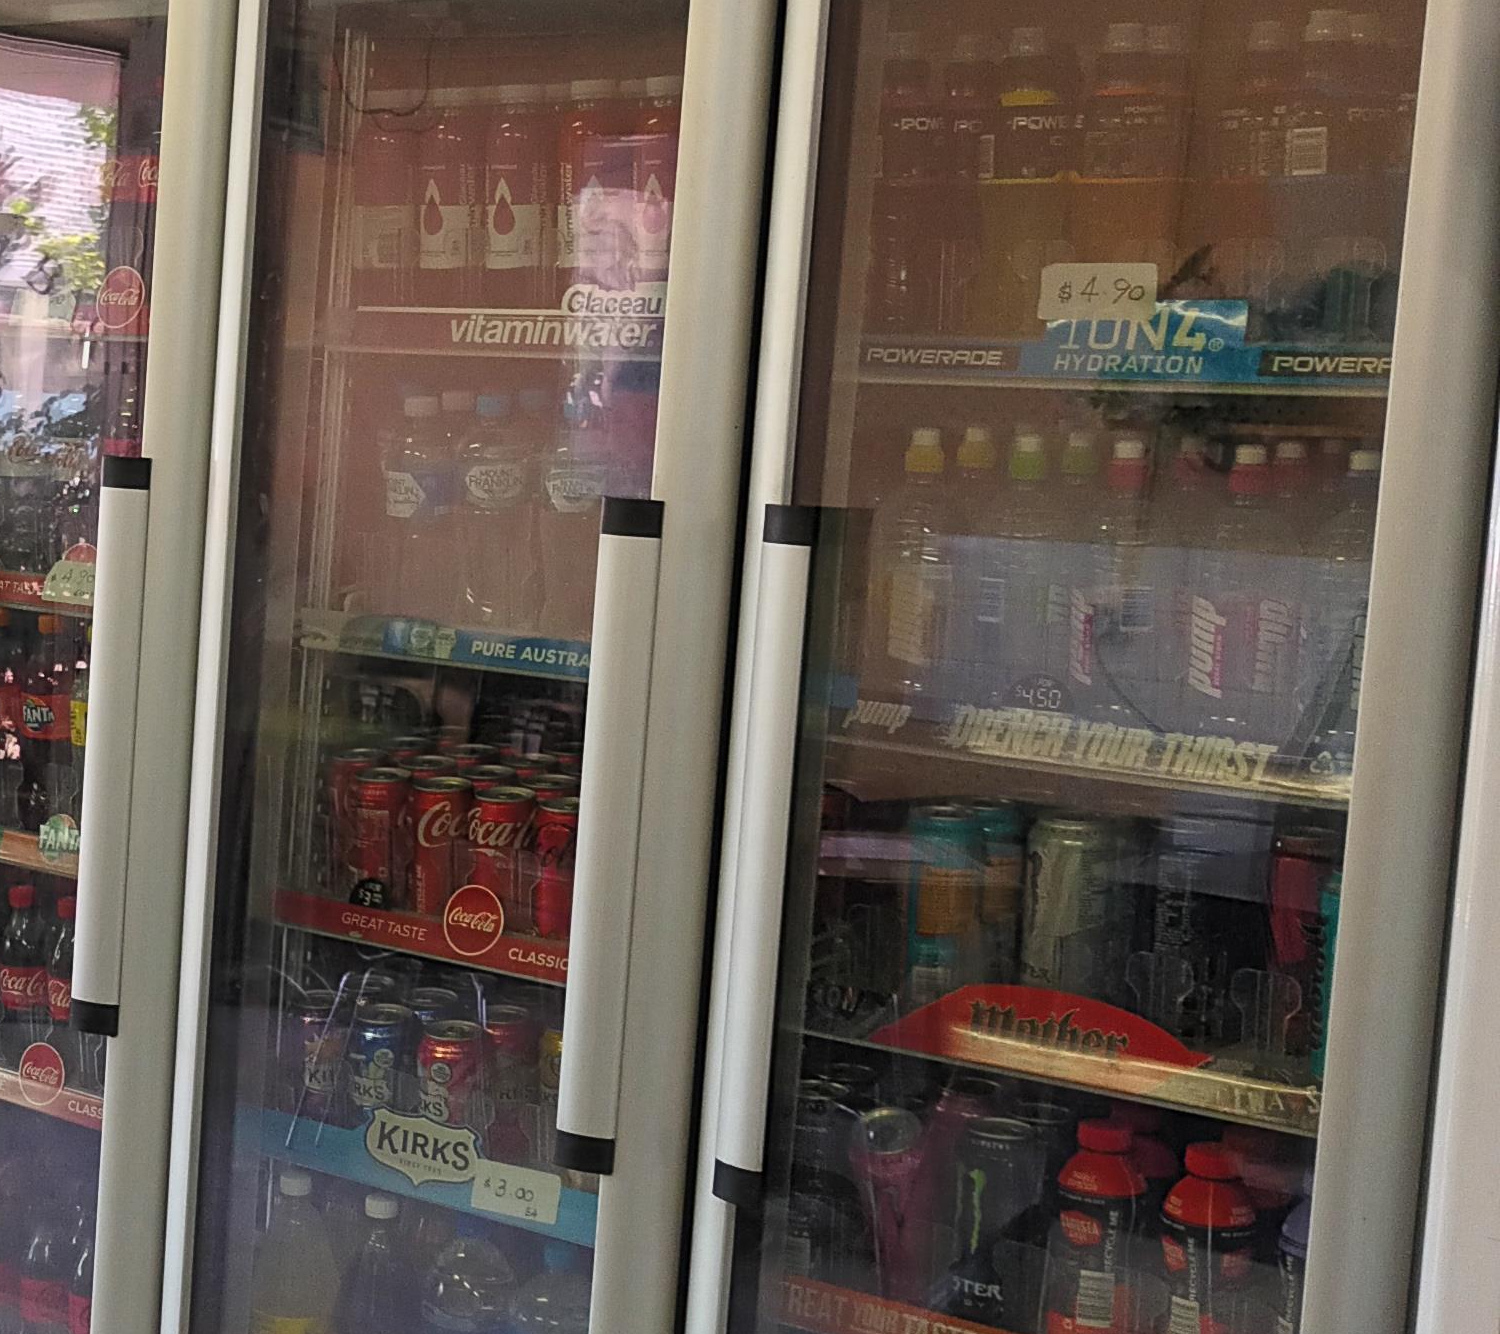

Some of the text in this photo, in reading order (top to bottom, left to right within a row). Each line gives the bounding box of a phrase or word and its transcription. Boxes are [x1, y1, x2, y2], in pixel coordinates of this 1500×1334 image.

[567, 290, 662, 315] Glaceau
[450, 315, 658, 349] vitaminwater
[866, 347, 1004, 367] POWERADE
[1053, 353, 1204, 375] HYDRATION
[470, 640, 592, 668] PURE AUSTRA
[1073, 717, 1155, 768] YOUR
[1161, 731, 1280, 782] THIRST
[340, 911, 430, 943] GREAT TASTE
[448, 906, 499, 934] Coca-Cola
[354, 1083, 385, 1101] RKS
[67, 1100, 104, 1118] CLASS
[376, 1120, 471, 1172] KIRKS
